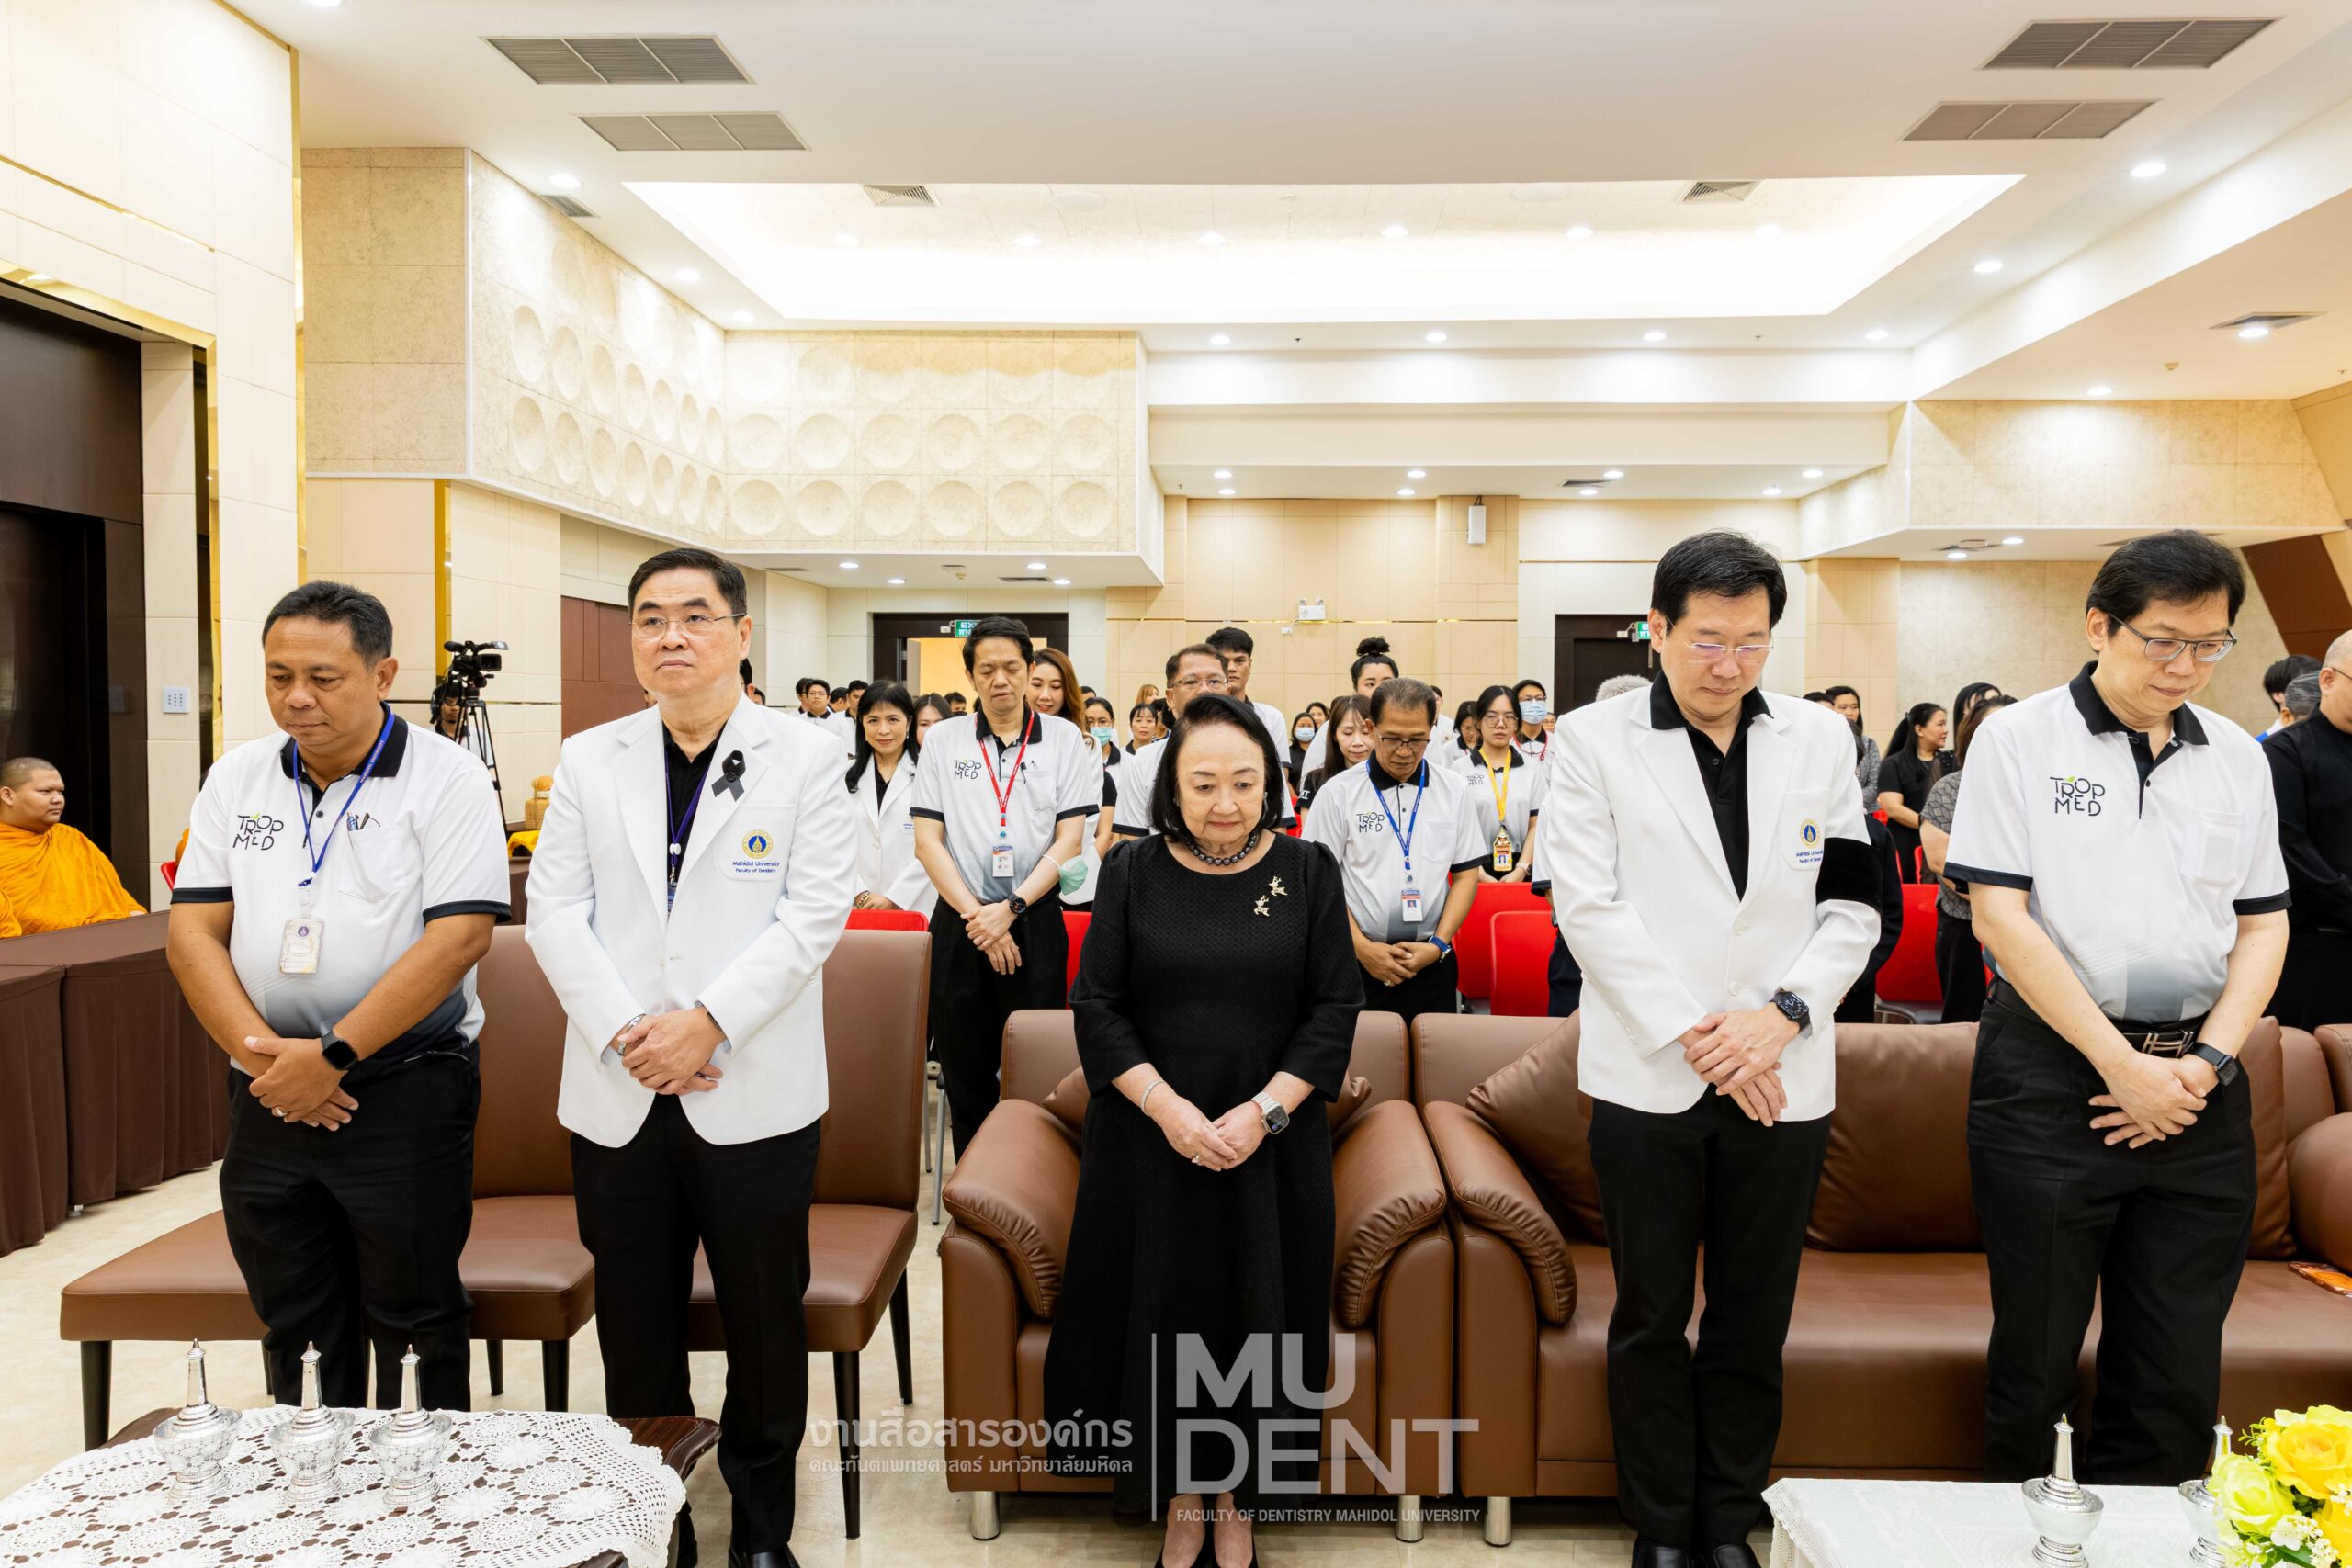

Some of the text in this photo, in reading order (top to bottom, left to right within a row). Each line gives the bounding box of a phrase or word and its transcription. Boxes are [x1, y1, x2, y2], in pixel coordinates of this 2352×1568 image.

[953, 760, 982, 771] TROP
[954, 768, 978, 779] MED
[2049, 776, 2106, 800] TROP
[2054, 795, 2101, 817] MED
[237, 814, 284, 835] TROP
[1355, 811, 1385, 825] TROP
[1359, 820, 1383, 833] MED
[232, 830, 275, 851] MED
